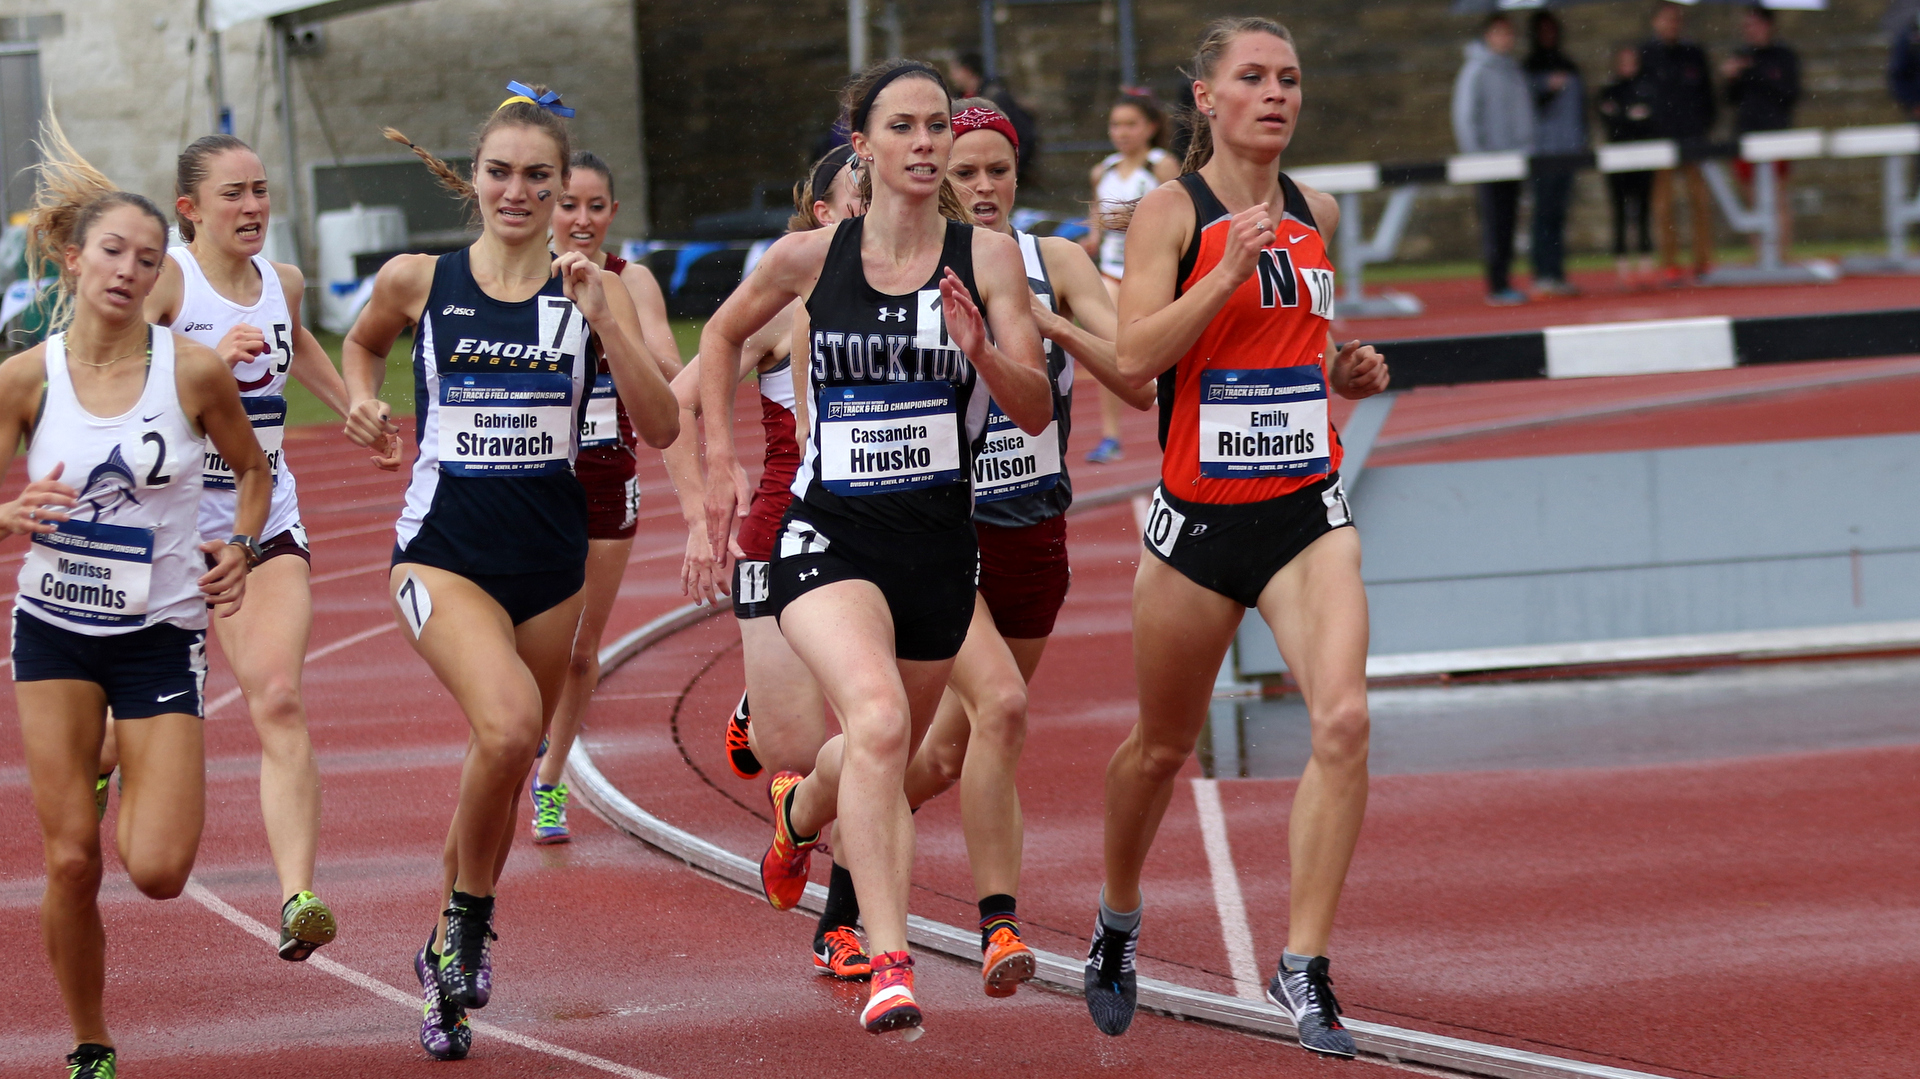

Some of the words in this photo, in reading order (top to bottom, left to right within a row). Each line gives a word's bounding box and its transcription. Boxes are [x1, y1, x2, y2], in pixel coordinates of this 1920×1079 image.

[1257, 248, 1298, 308] N
[1311, 268, 1331, 315] 10
[453, 307, 476, 316] asics
[193, 323, 214, 331] asics
[548, 300, 573, 349] 7
[273, 323, 291, 373] 5
[454, 338, 563, 362] EMORY
[450, 355, 559, 372] EAGLES
[462, 391, 484, 399] TRACK
[484, 391, 491, 399] &
[491, 391, 509, 400] FIELD
[510, 391, 566, 400] CHAMPIONSHIPS
[1224, 388, 1247, 397] TRACK
[1247, 388, 1254, 396] &
[1254, 387, 1273, 397] FIELD
[843, 405, 865, 414] TRACK
[865, 404, 871, 413] &
[871, 403, 889, 413] FIELD
[890, 398, 949, 411] CHAMPIONSHIPS
[474, 413, 537, 428] Gabrielle
[1251, 410, 1289, 428] Emily
[456, 431, 553, 456] Stravach
[851, 424, 927, 444] Cassandra
[981, 436, 1025, 455] essica
[1218, 429, 1314, 456] Richards
[141, 431, 171, 486] 2
[850, 444, 931, 473] Hrusko
[1147, 498, 1172, 546] 10
[70, 538, 90, 548] FIELD
[89, 541, 147, 556] CHAMPIONSHIPS
[58, 557, 111, 580] Marissa
[40, 573, 126, 609] Coombs
[746, 564, 769, 600] 11
[400, 577, 422, 629] 7
